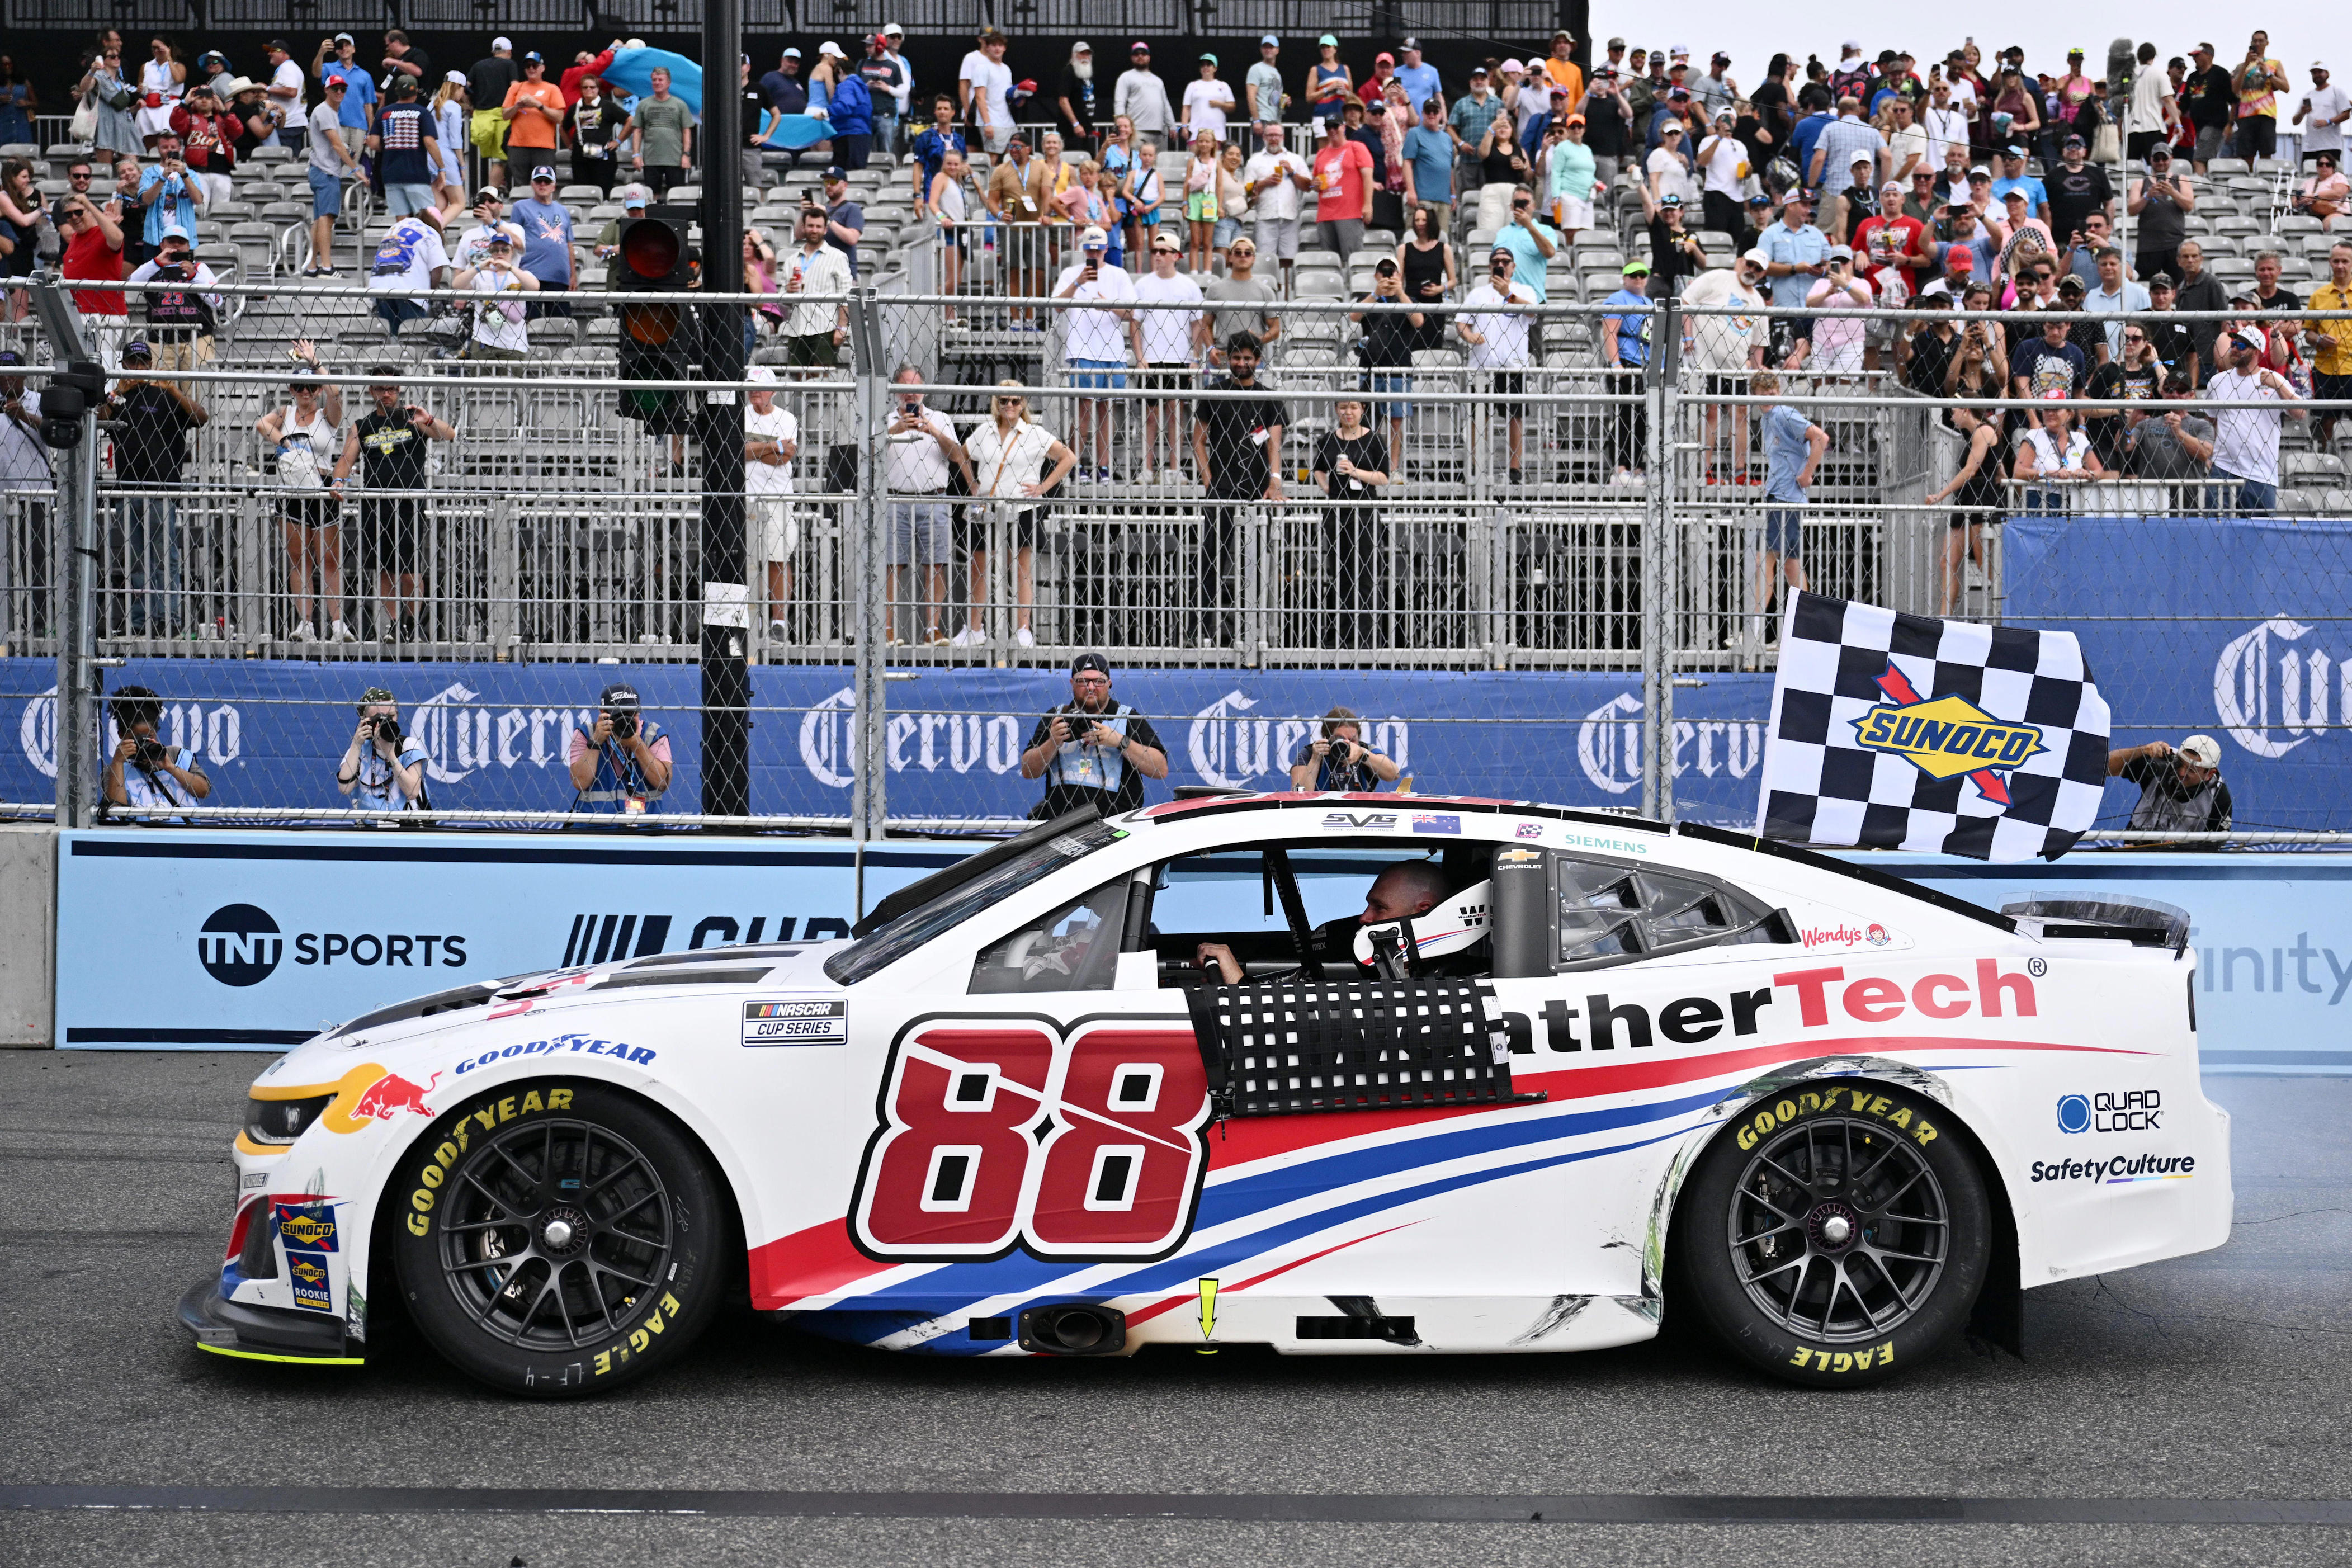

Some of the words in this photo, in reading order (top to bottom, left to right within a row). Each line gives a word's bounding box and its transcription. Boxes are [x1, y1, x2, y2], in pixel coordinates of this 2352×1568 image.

[390, 110, 421, 119] NASCAR
[161, 292, 185, 306] 23
[1865, 712, 2034, 762] SUNOCO
[1321, 814, 1400, 828] SVG
[1565, 834, 1647, 854] SIEMENS
[1801, 924, 1862, 948] Wendy's
[199, 932, 282, 966] TNT
[294, 933, 467, 967] SPORTS
[776, 1003, 832, 1017] NASCAR
[757, 1023, 785, 1035] CUP
[785, 1022, 832, 1034] SERIES
[455, 1033, 657, 1075] GOODYEAR
[2094, 1090, 2161, 1112] QUAD
[1736, 1086, 1938, 1151] GOODYEAR
[2095, 1110, 2161, 1132] LOCK
[846, 1012, 1213, 1264] 88
[407, 1088, 574, 1238] GOODYEAR
[2030, 1154, 2195, 1184] SafetyCulture
[283, 1224, 332, 1236] SUNOCO
[294, 1266, 325, 1278] SUNOCO
[295, 1287, 329, 1301] ROOKIE
[594, 1291, 680, 1376] EAGLE
[1789, 1340, 1895, 1373] EAGLE
